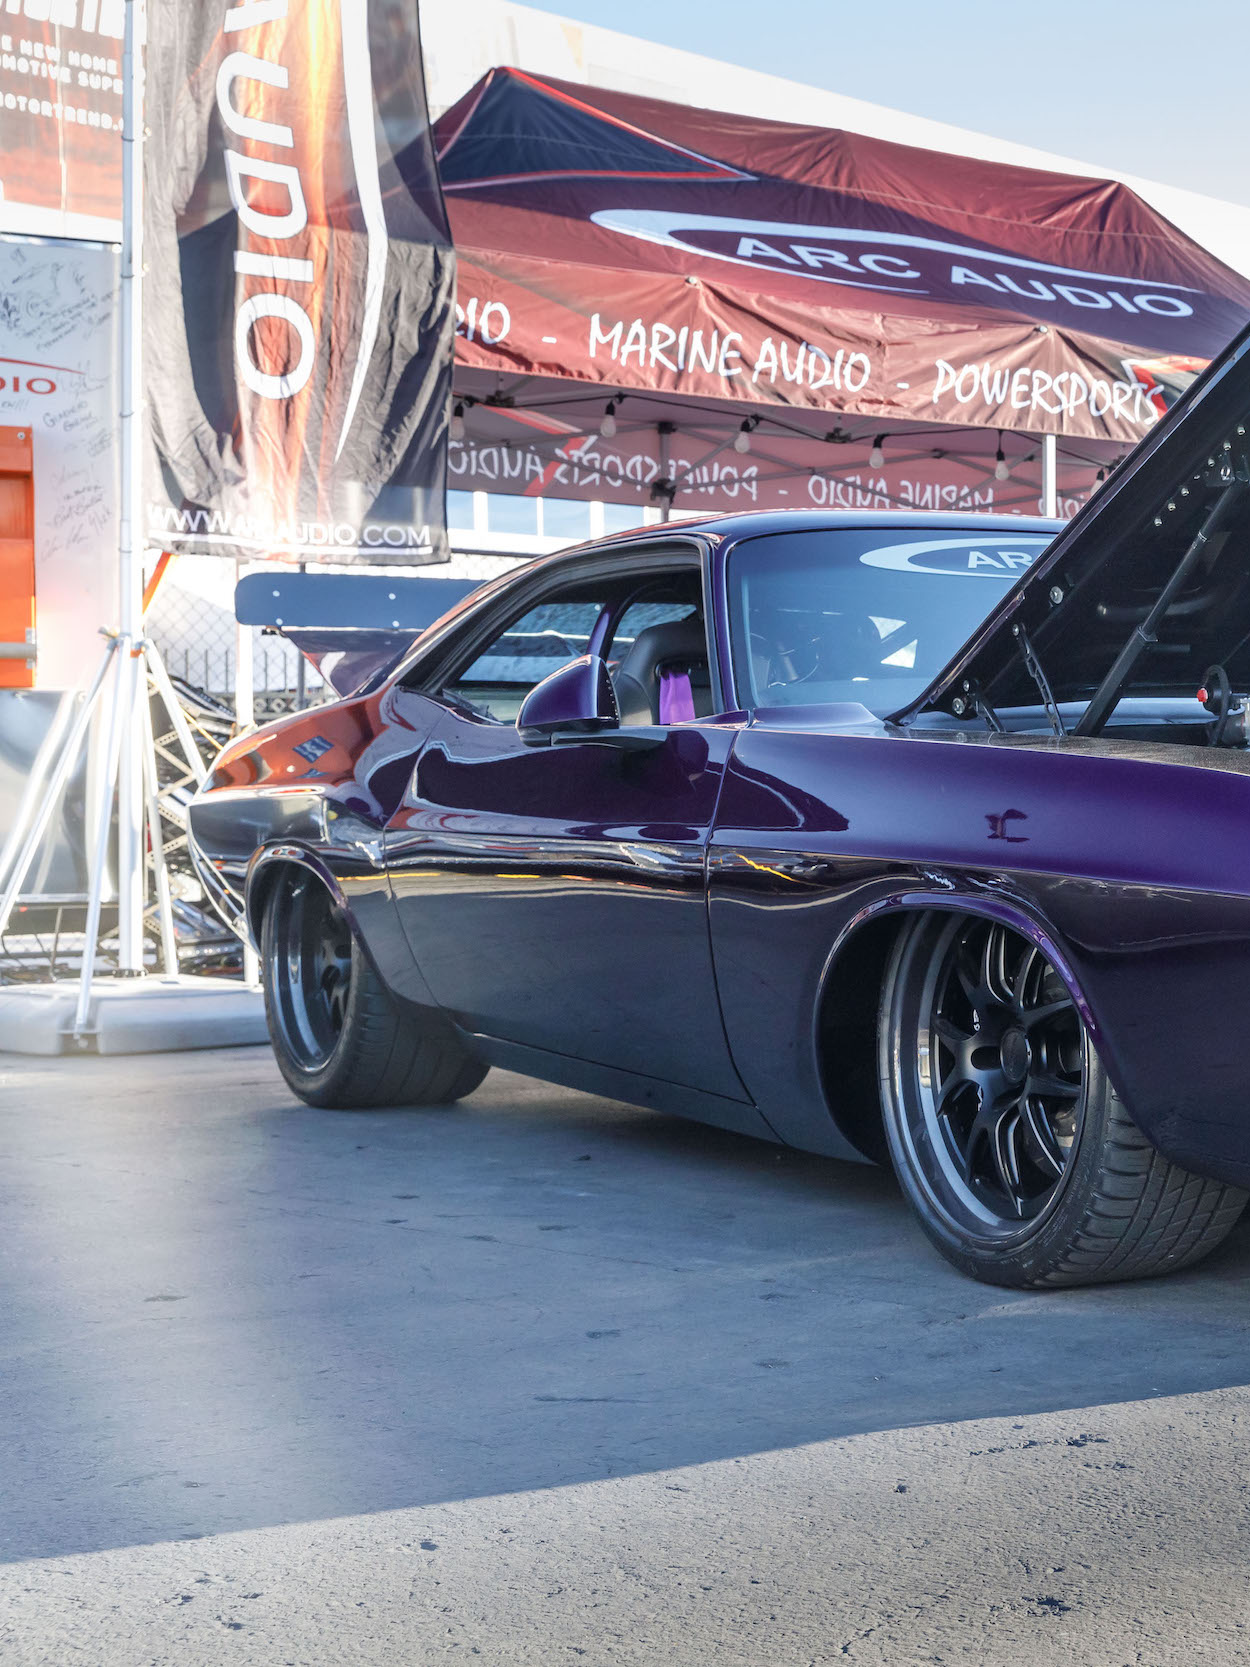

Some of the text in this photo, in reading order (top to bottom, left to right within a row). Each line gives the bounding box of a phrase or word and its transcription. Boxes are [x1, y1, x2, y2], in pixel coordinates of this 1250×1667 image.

[20, 39, 60, 62] NEW
[68, 50, 117, 75] HOME
[737, 237, 1193, 318] ARC AUDIO
[589, 313, 742, 378] MARINE
[752, 337, 871, 392] AUDIO
[932, 358, 1164, 425] POWERSPORTS
[147, 503, 431, 547] WWW.ARAUDIO.COM
